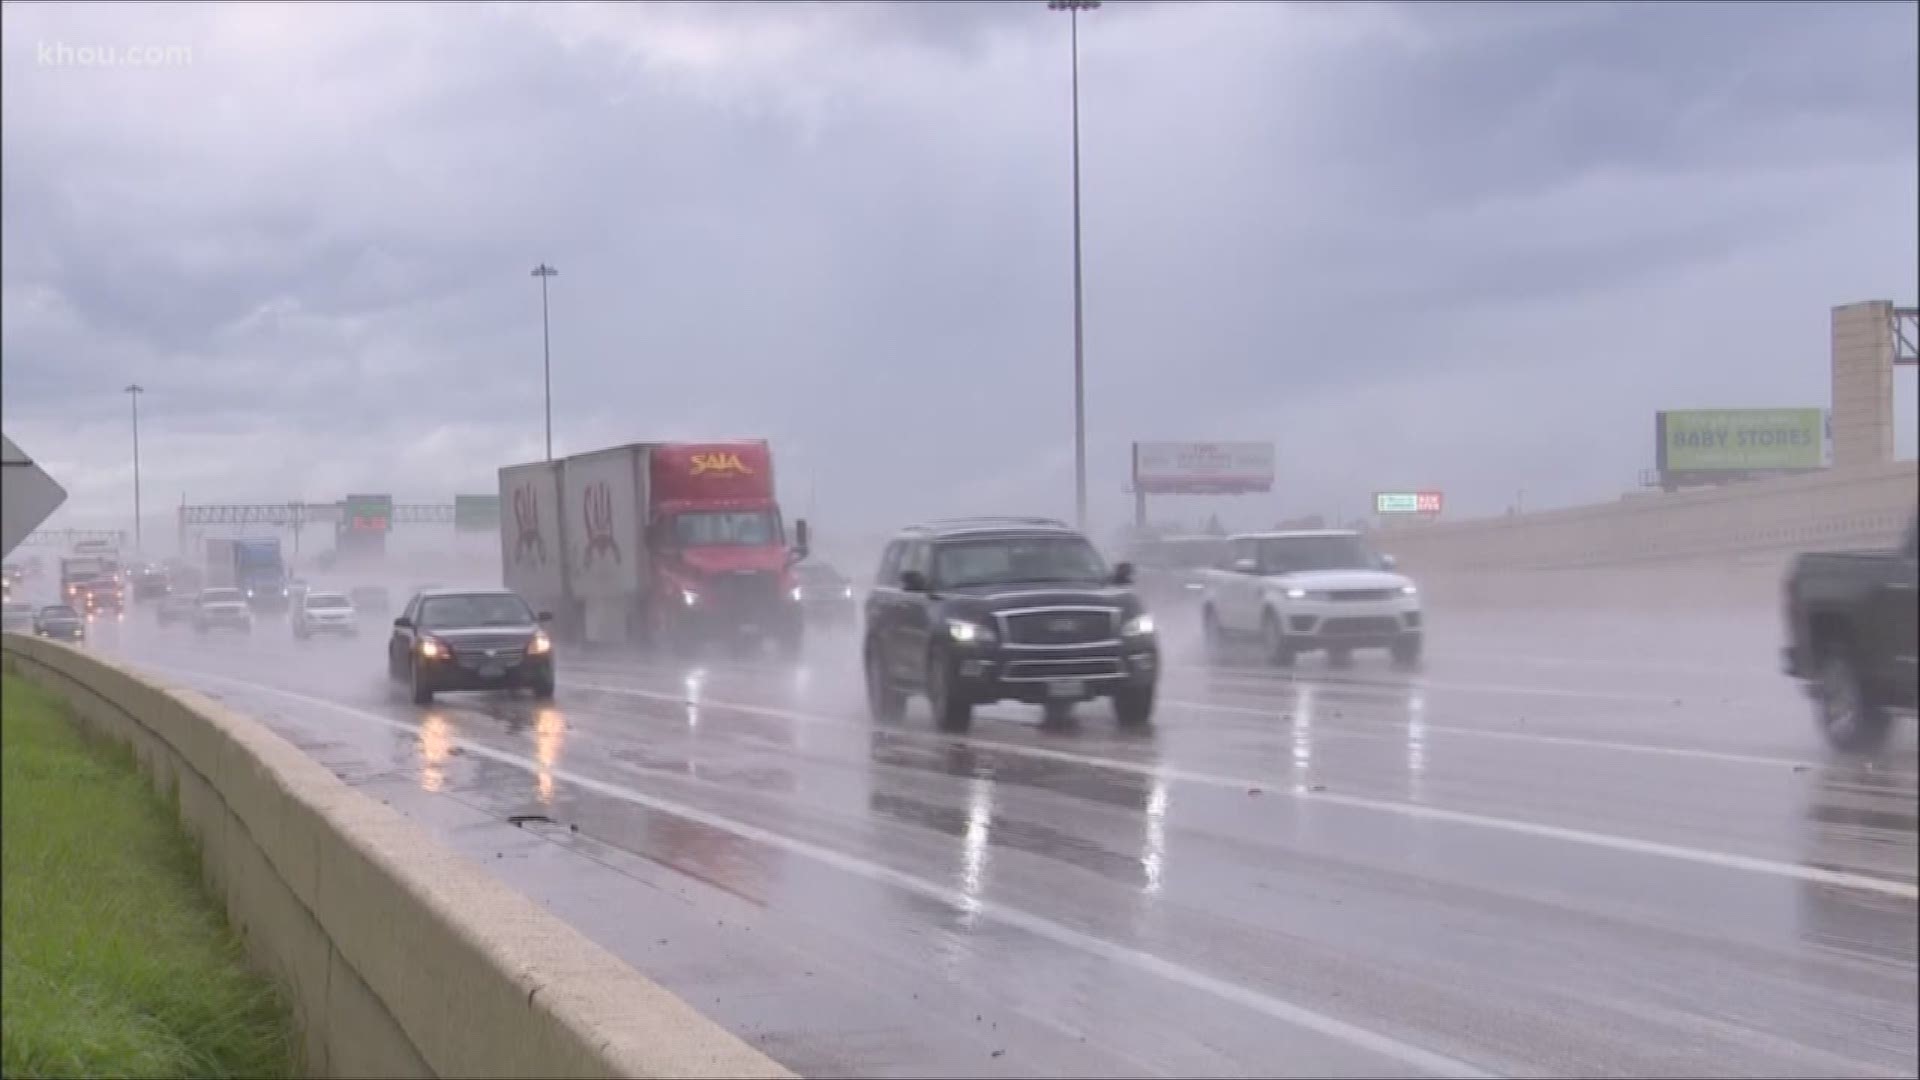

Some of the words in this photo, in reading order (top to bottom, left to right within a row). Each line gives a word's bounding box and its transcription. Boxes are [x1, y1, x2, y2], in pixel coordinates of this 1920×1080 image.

[1673, 431, 1727, 448] BABY
[1737, 428, 1812, 447] STORES
[690, 454, 753, 475] SAIA
